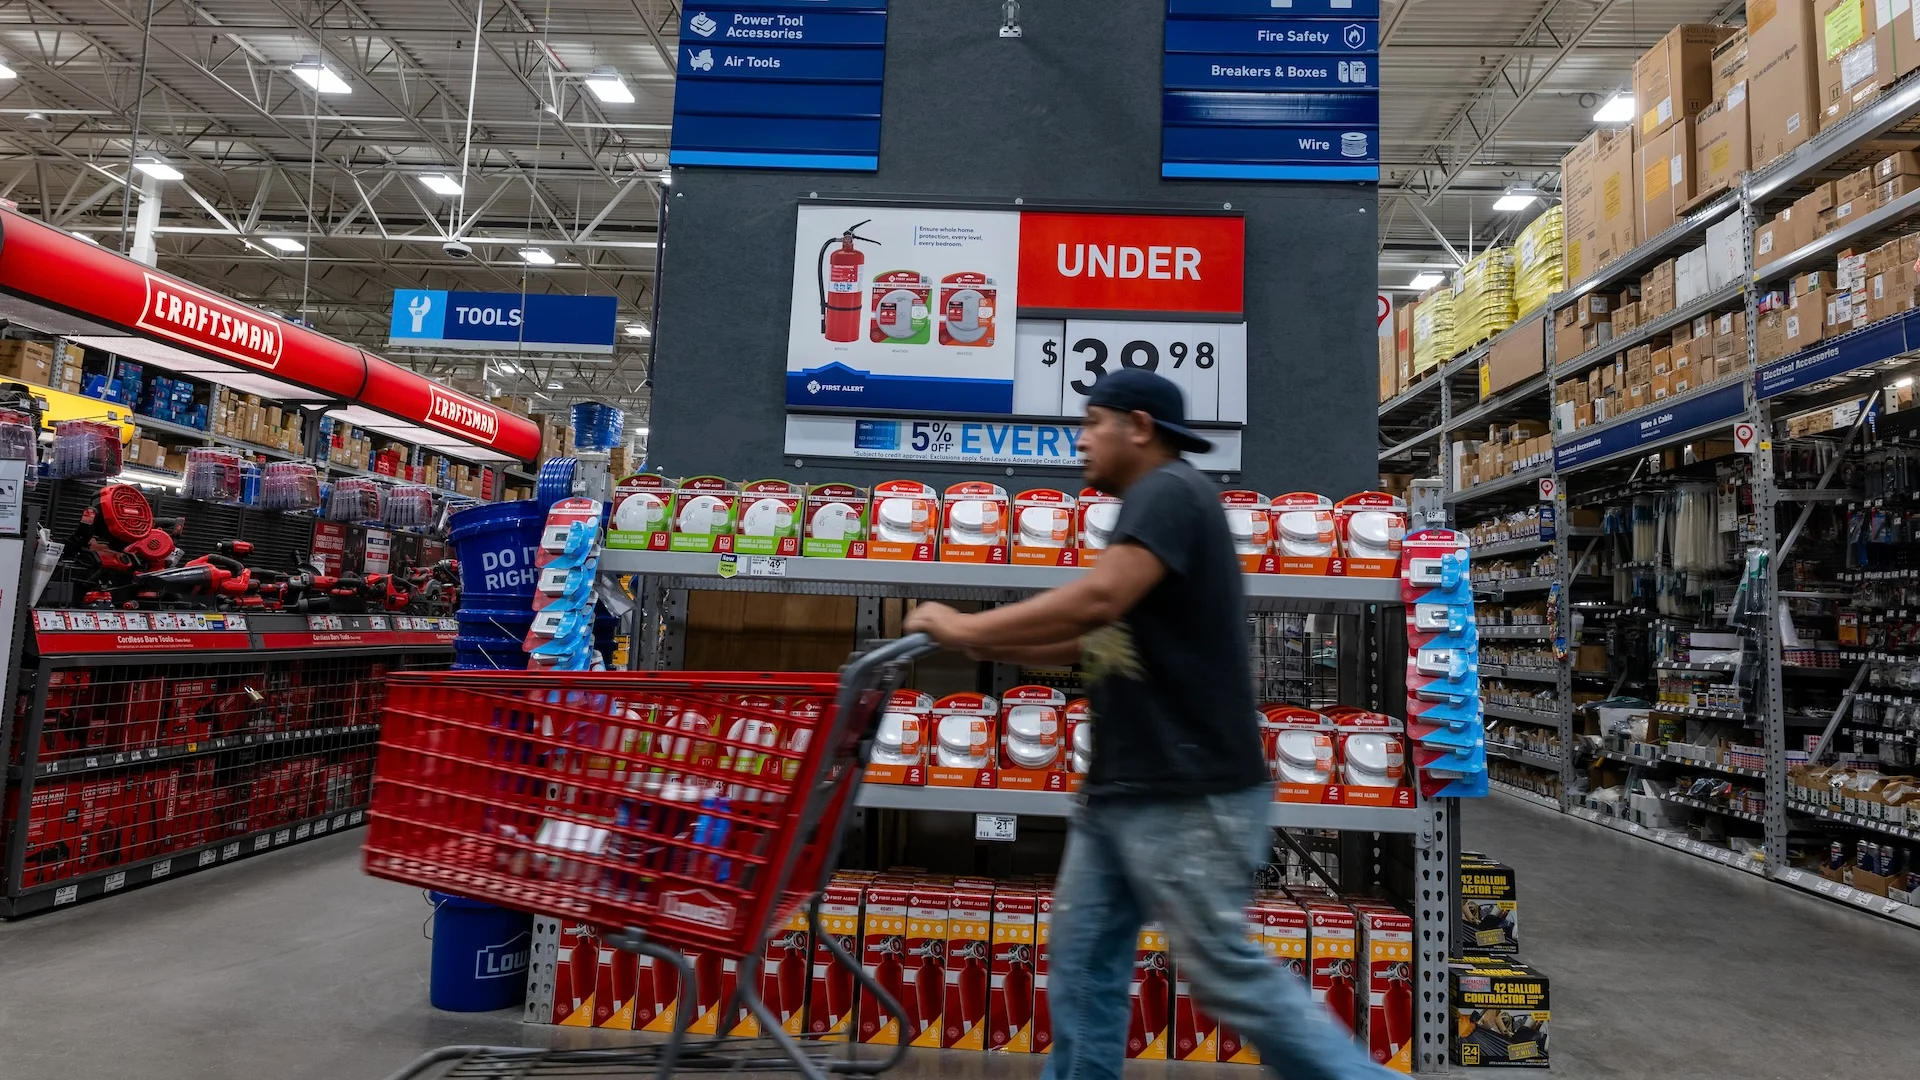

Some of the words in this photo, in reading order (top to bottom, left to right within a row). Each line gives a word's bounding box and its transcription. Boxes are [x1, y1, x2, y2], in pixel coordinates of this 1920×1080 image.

[734, 14, 774, 26] Power
[777, 15, 804, 26] Tool
[726, 27, 803, 39] Accessories
[1258, 30, 1284, 42] Fire
[1287, 30, 1329, 44] Safety
[724, 56, 744, 67] Air
[747, 56, 780, 68] Tools
[1211, 64, 1271, 77] Breakers
[1274, 66, 1284, 78] &
[1288, 66, 1328, 78] Boxes
[1298, 138, 1330, 150] Wire
[1057, 243, 1202, 280] UNDER
[154, 290, 276, 355] CRAFTSMAN
[456, 307, 522, 326] TOOLS
[1042, 339, 1058, 367] $
[1169, 342, 1214, 370] 98
[1763, 362, 1794, 380] Electrical
[1796, 348, 1839, 369] Accessories
[97, 386, 117, 396] KOALT
[435, 396, 495, 434] CRAFTSMAN
[1641, 420, 1652, 430] Wire
[1658, 413, 1673, 424] Cable
[912, 422, 952, 452] 5%
[1558, 446, 1577, 457] Electrical
[1577, 438, 1601, 452] Accessories
[920, 546, 928, 554] 2
[1064, 552, 1072, 560] 2
[482, 549, 516, 571] DO
[1265, 558, 1274, 567] 2
[1333, 560, 1342, 569] 2
[911, 769, 919, 777] 2
[982, 772, 990, 781] 2
[1052, 776, 1060, 784] 2
[1329, 787, 1338, 795] 2
[1400, 791, 1408, 800] 2
[1461, 875, 1472, 884] 42
[1474, 876, 1506, 885] GALLON
[1462, 885, 1491, 894] ACTOR
[1494, 983, 1506, 993] 42
[1507, 984, 1541, 994] GALLON
[1464, 993, 1525, 1004] CONTRACTOR
[1464, 1046, 1477, 1055] 24
